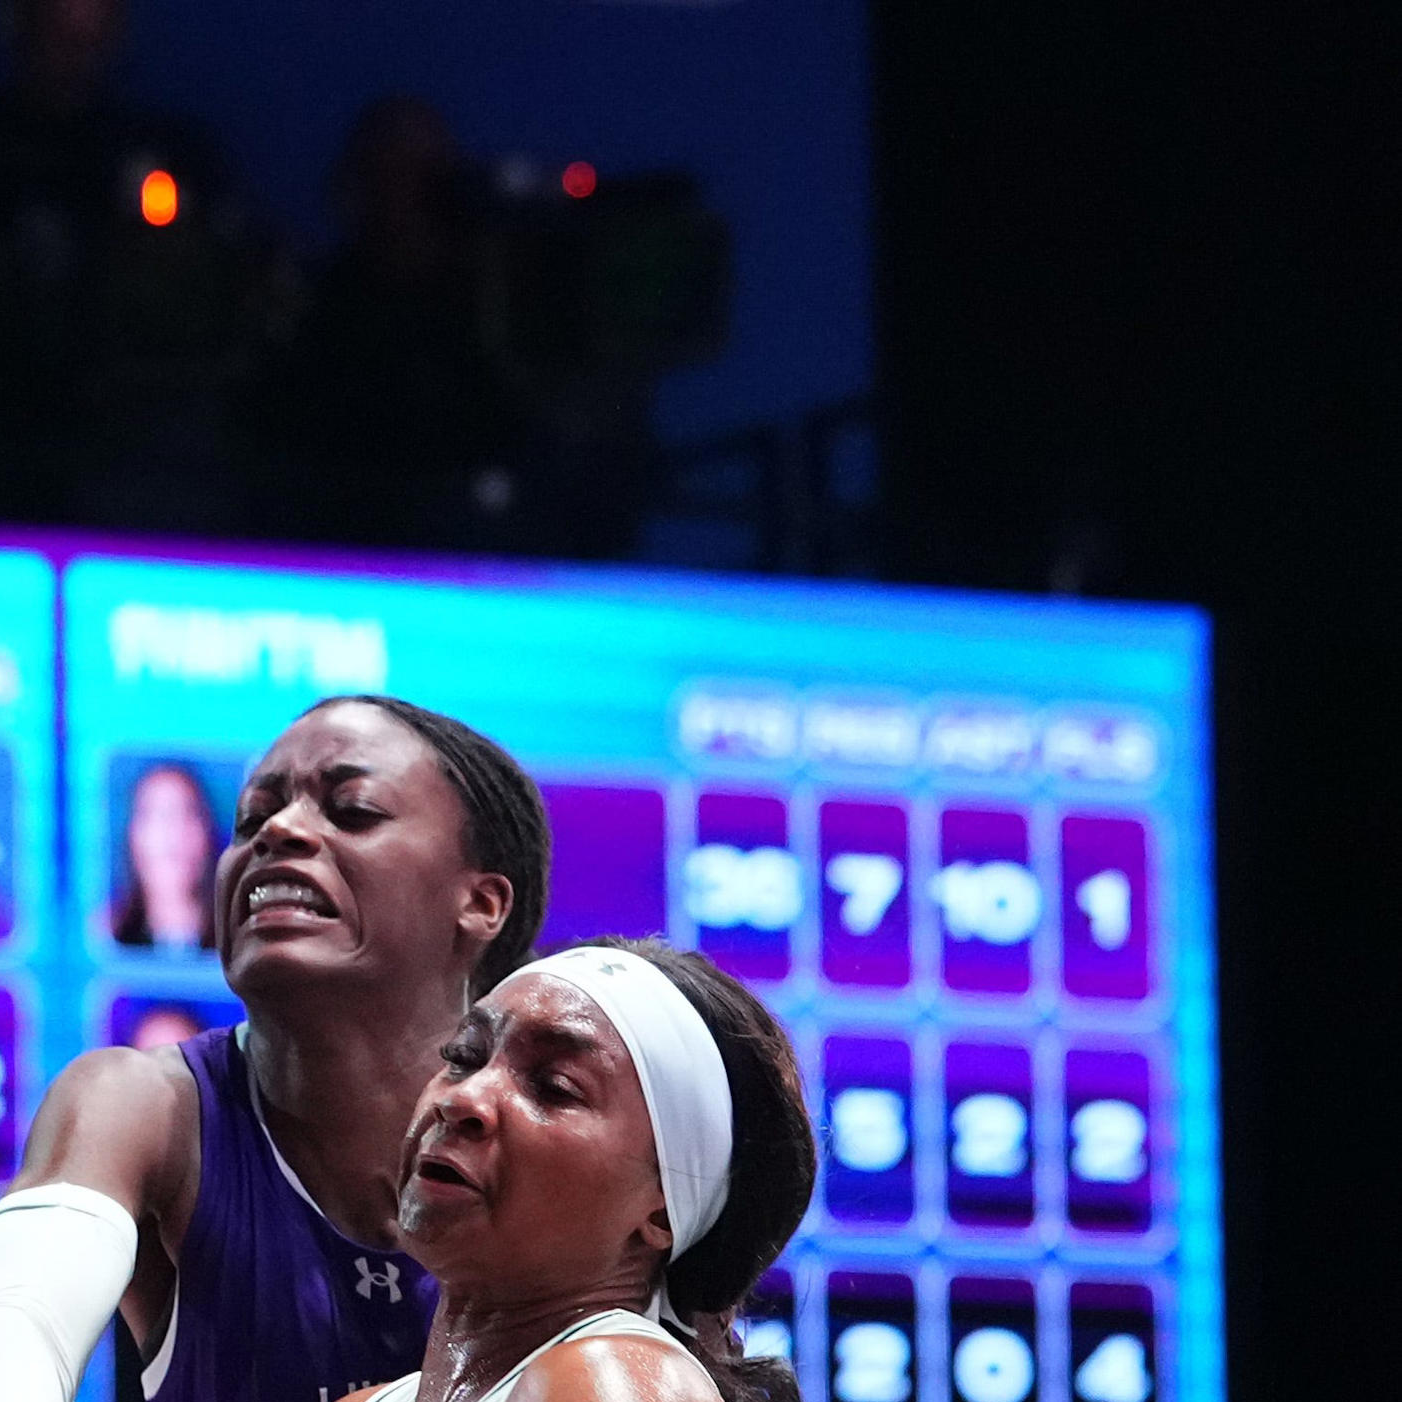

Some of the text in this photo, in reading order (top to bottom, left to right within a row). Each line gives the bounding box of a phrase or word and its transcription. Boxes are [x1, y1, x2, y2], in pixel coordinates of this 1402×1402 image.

[826, 853, 902, 934] 7
[930, 862, 1042, 945] 10
[1077, 870, 1130, 950] 1
